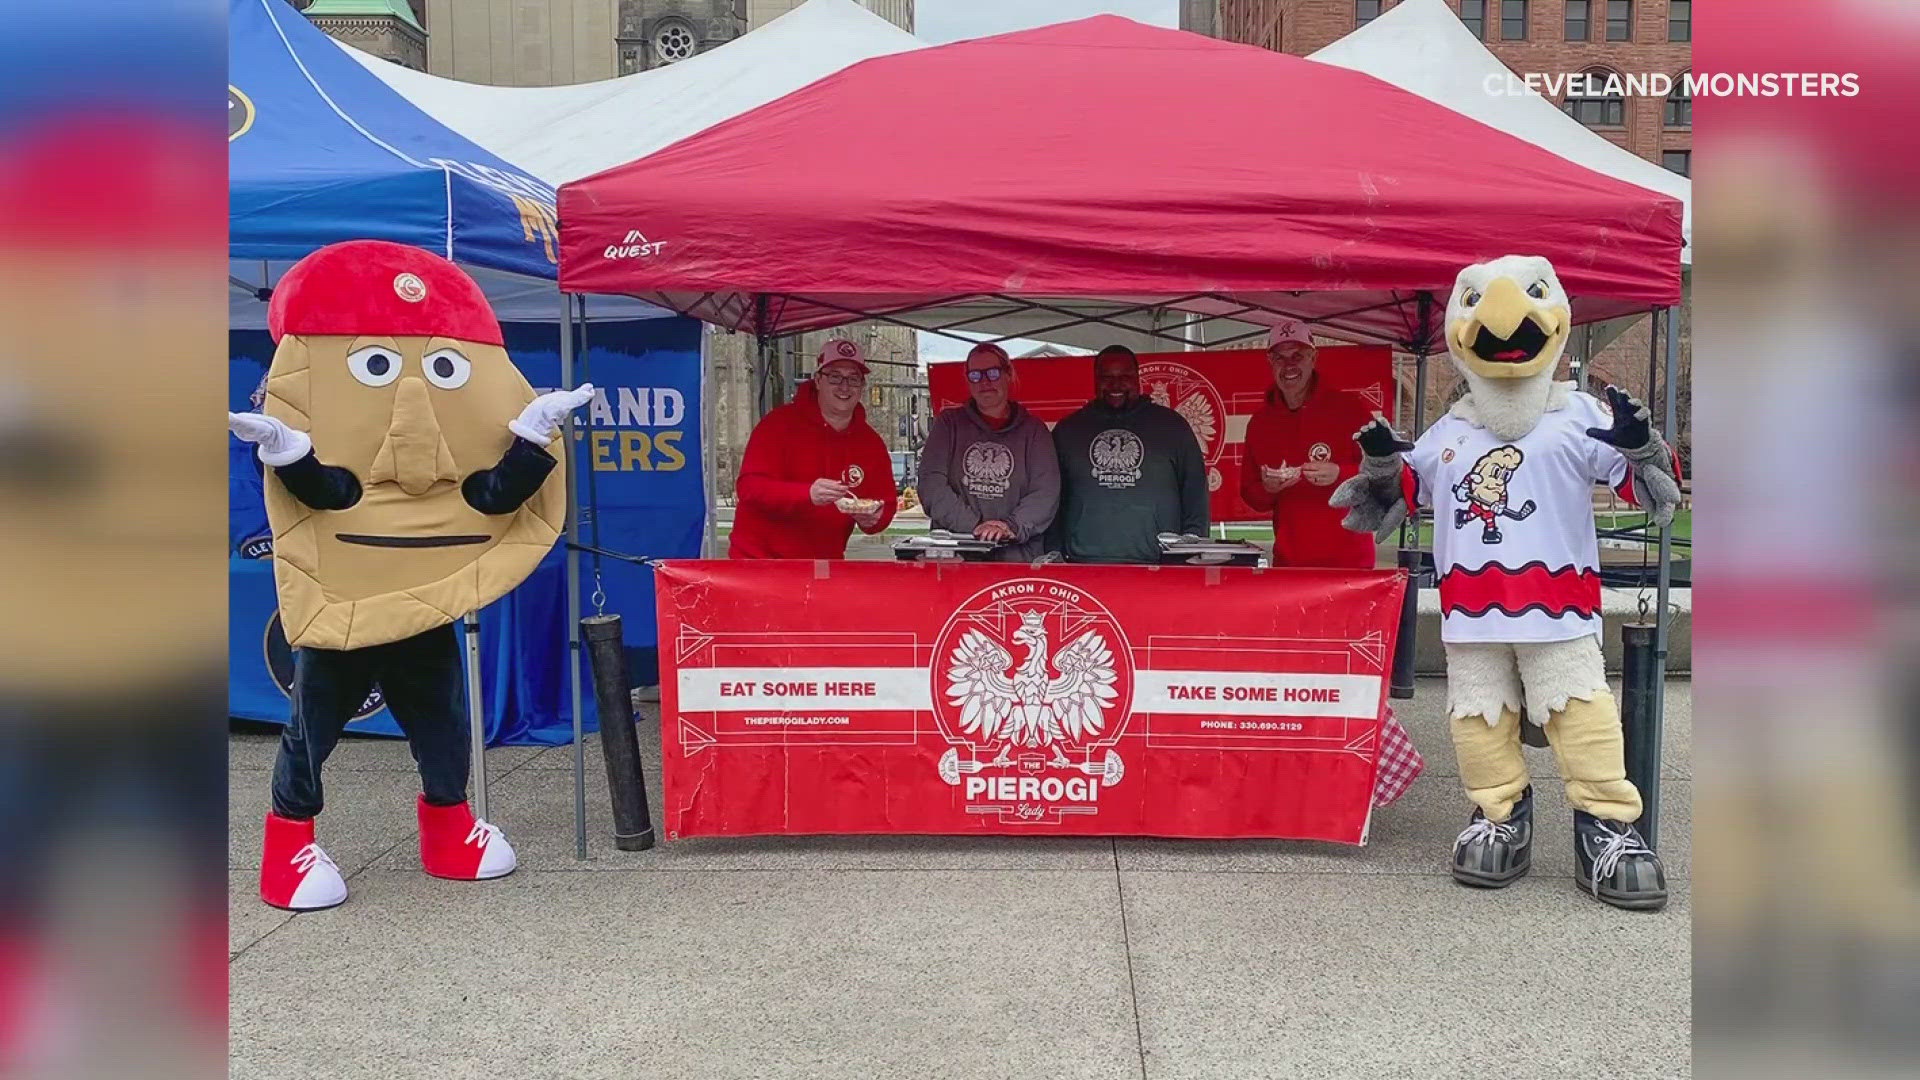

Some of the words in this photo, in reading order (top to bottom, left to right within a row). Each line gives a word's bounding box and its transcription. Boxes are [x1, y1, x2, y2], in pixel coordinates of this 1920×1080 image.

[603, 241, 667, 260] QUEST
[1138, 366, 1160, 375] KRON
[991, 584, 1035, 601] AKRON
[1049, 587, 1080, 603] OHIO
[720, 682, 756, 697] EAT
[763, 682, 818, 697] SOME
[825, 682, 877, 697] HERE
[1167, 685, 1216, 701] TAKE
[1222, 686, 1278, 702] SOME
[1284, 688, 1340, 703] HOME
[744, 716, 850, 726] THEPIEROGILADY.COM
[1200, 720, 1237, 729] PHONE:
[1023, 762, 1041, 770] THE
[966, 777, 1098, 802] PIEROGI
[1015, 803, 1045, 820] Lady
